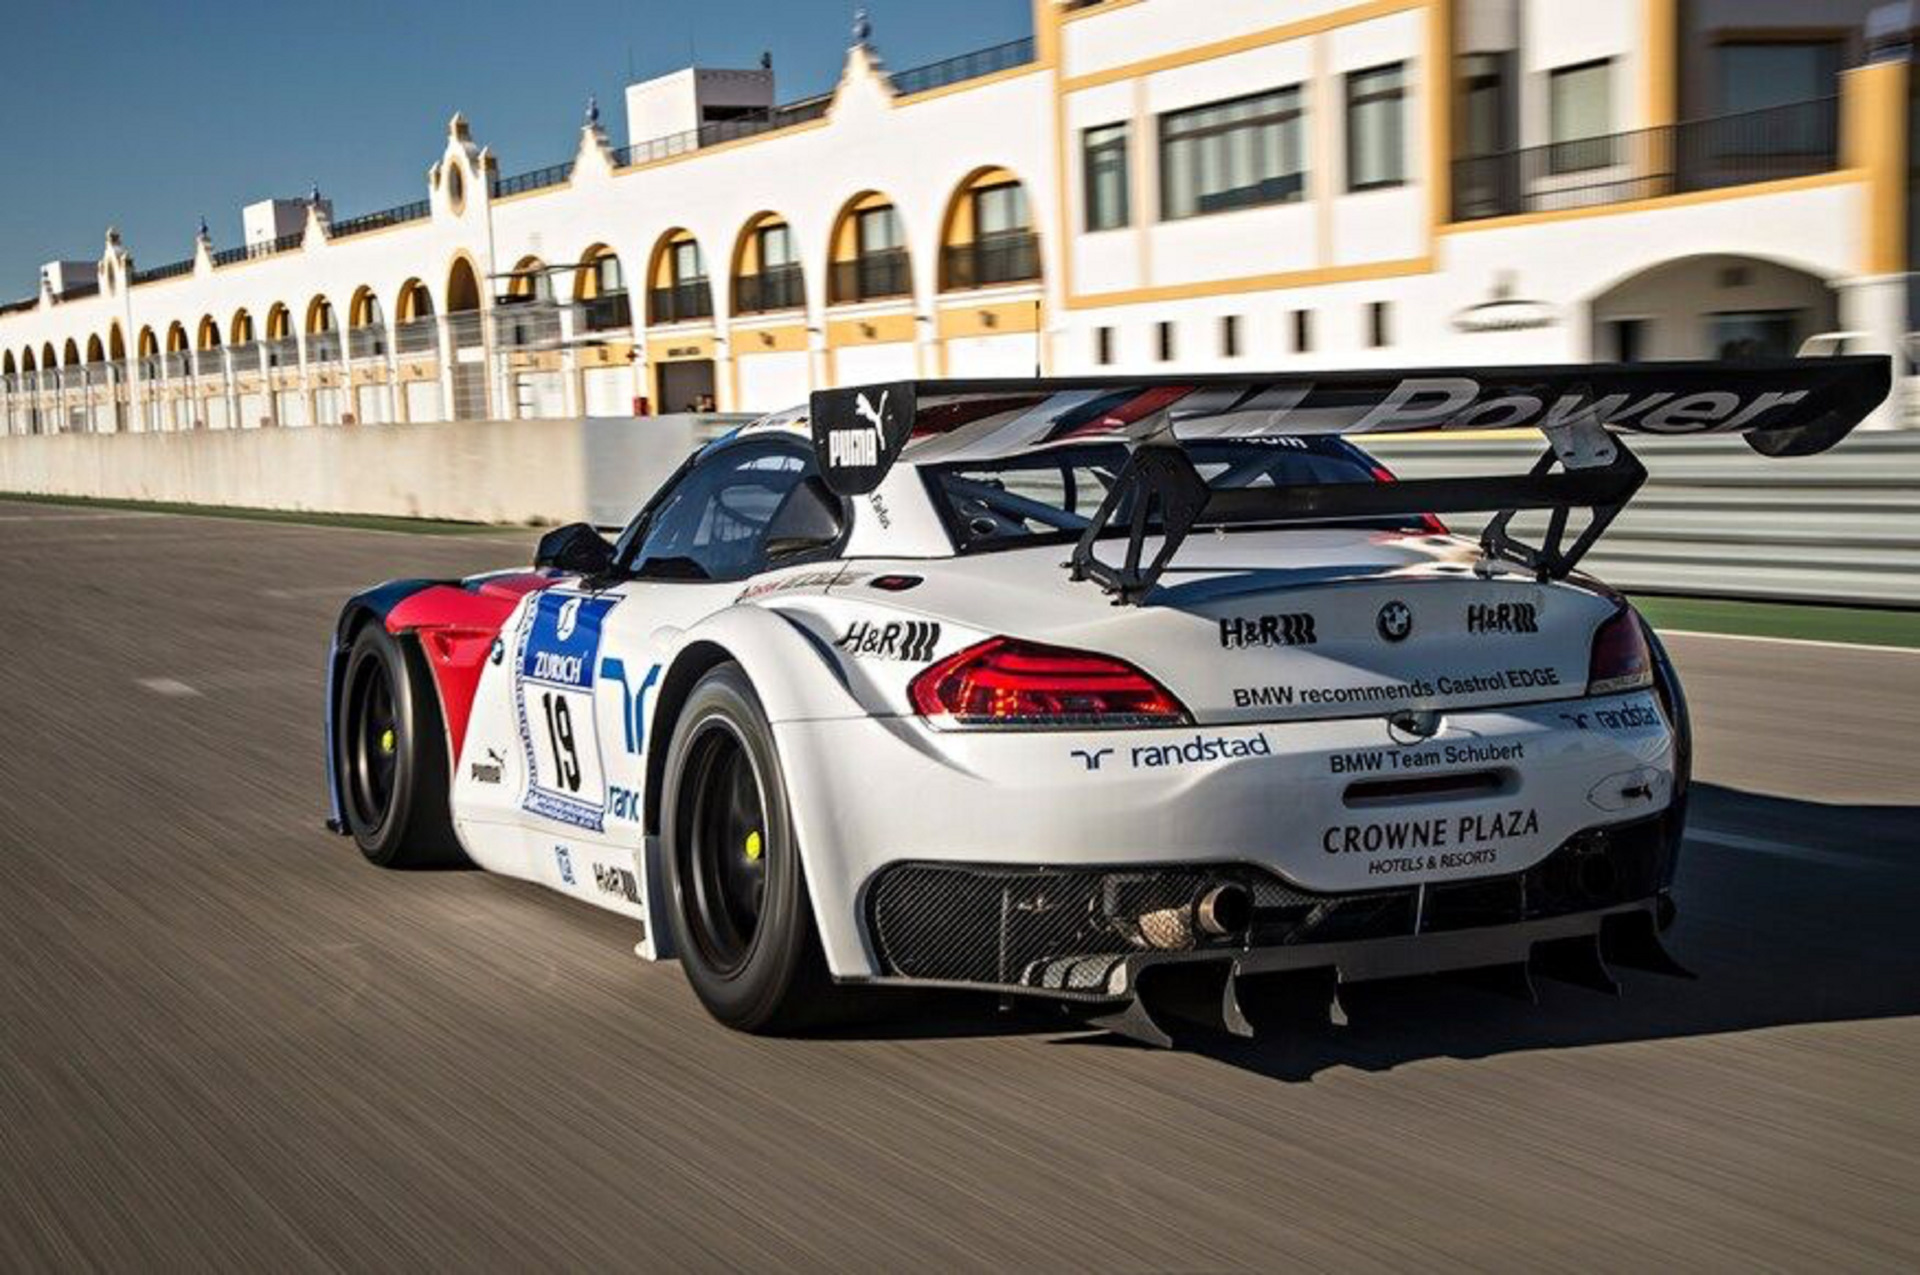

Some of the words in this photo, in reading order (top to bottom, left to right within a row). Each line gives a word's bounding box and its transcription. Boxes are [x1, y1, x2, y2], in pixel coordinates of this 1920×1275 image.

[1346, 378, 1808, 433] Power
[828, 428, 878, 468] PUMA
[1220, 614, 1282, 648] H&R
[1468, 603, 1514, 633] H&R
[833, 620, 904, 658] H&R
[532, 650, 583, 684] ZURICH
[1233, 685, 1293, 707] BMW
[1299, 678, 1434, 704] recommends
[1437, 671, 1508, 695] Castrol
[1505, 667, 1560, 688] EDGE
[542, 691, 582, 793] 19
[1131, 732, 1271, 767] randstad
[1330, 752, 1383, 773] BMW
[1387, 750, 1440, 769] Team
[1445, 742, 1524, 764] Schubert
[1323, 819, 1447, 854] CROWNE
[1459, 809, 1539, 843] PLAZA
[1368, 856, 1423, 875] HOTELS
[1426, 855, 1437, 869] &
[1440, 849, 1497, 868] RESORTS
